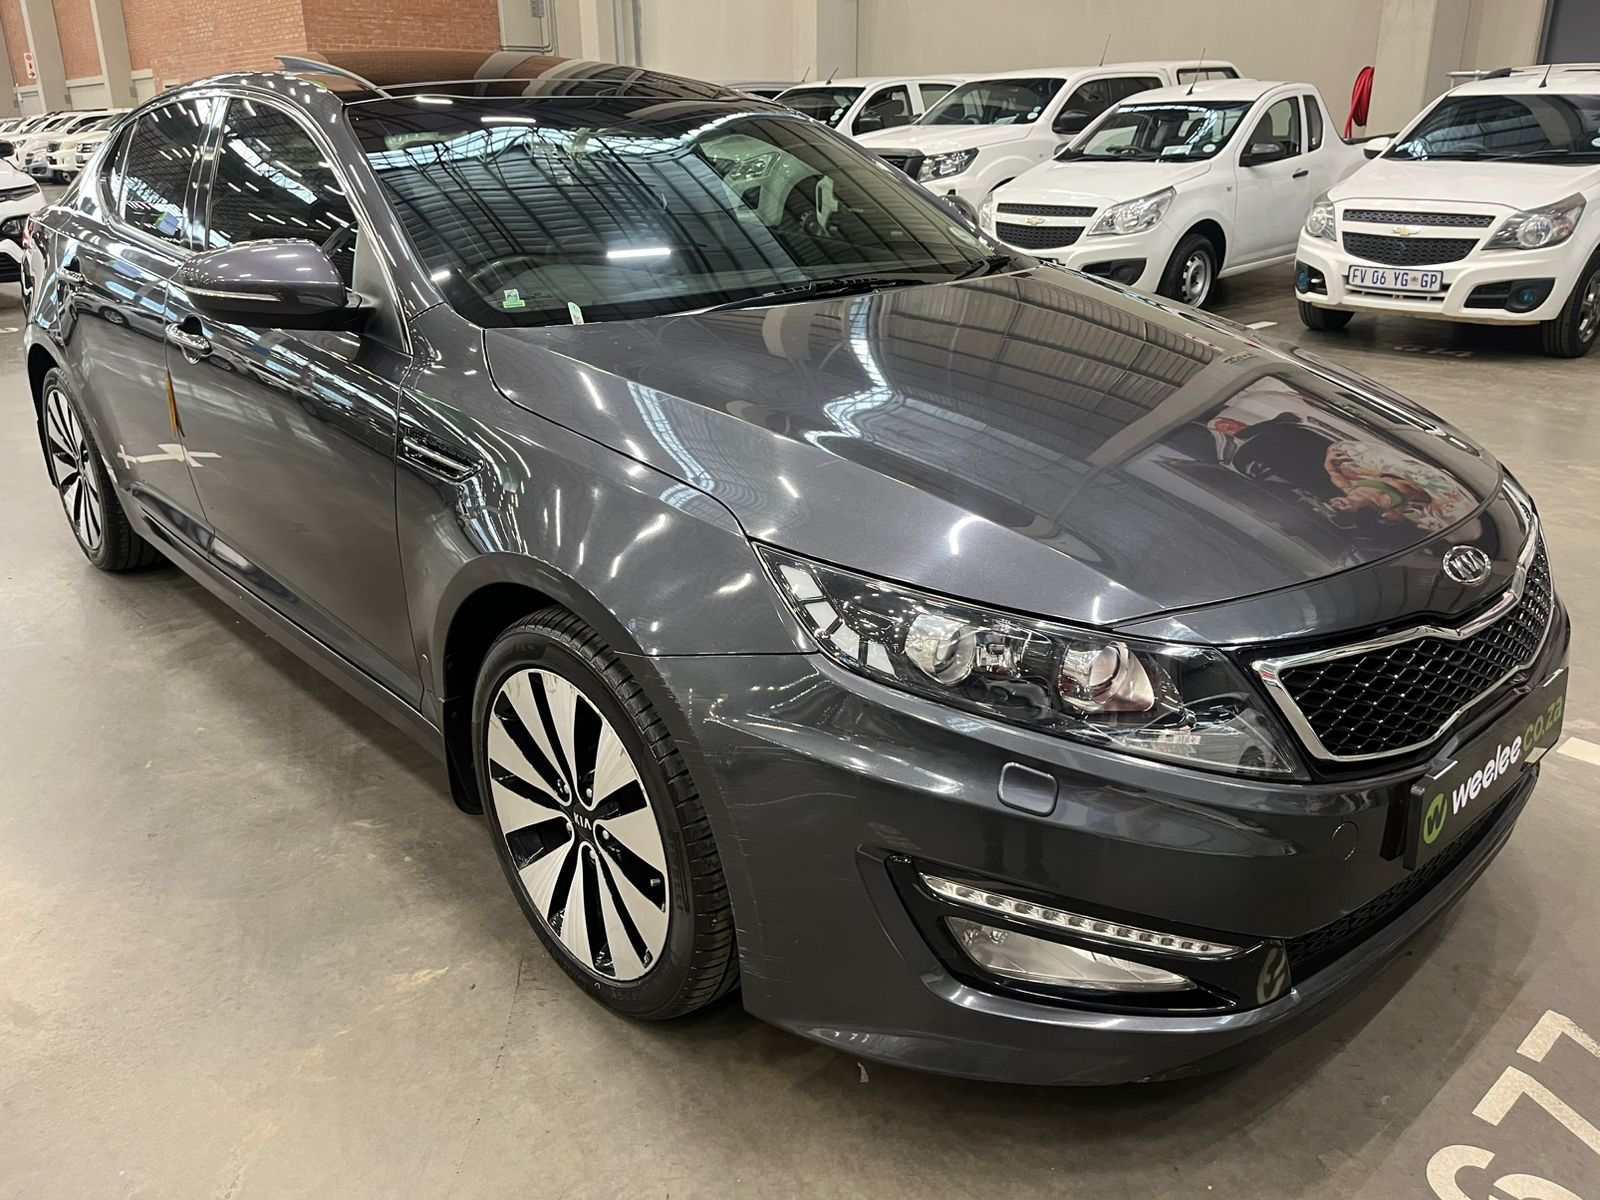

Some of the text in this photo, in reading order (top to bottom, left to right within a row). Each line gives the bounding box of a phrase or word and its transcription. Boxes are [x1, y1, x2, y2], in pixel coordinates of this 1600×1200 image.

[1352, 268, 1438, 288] FV 06 YG GP
[573, 811, 592, 830] KIA
